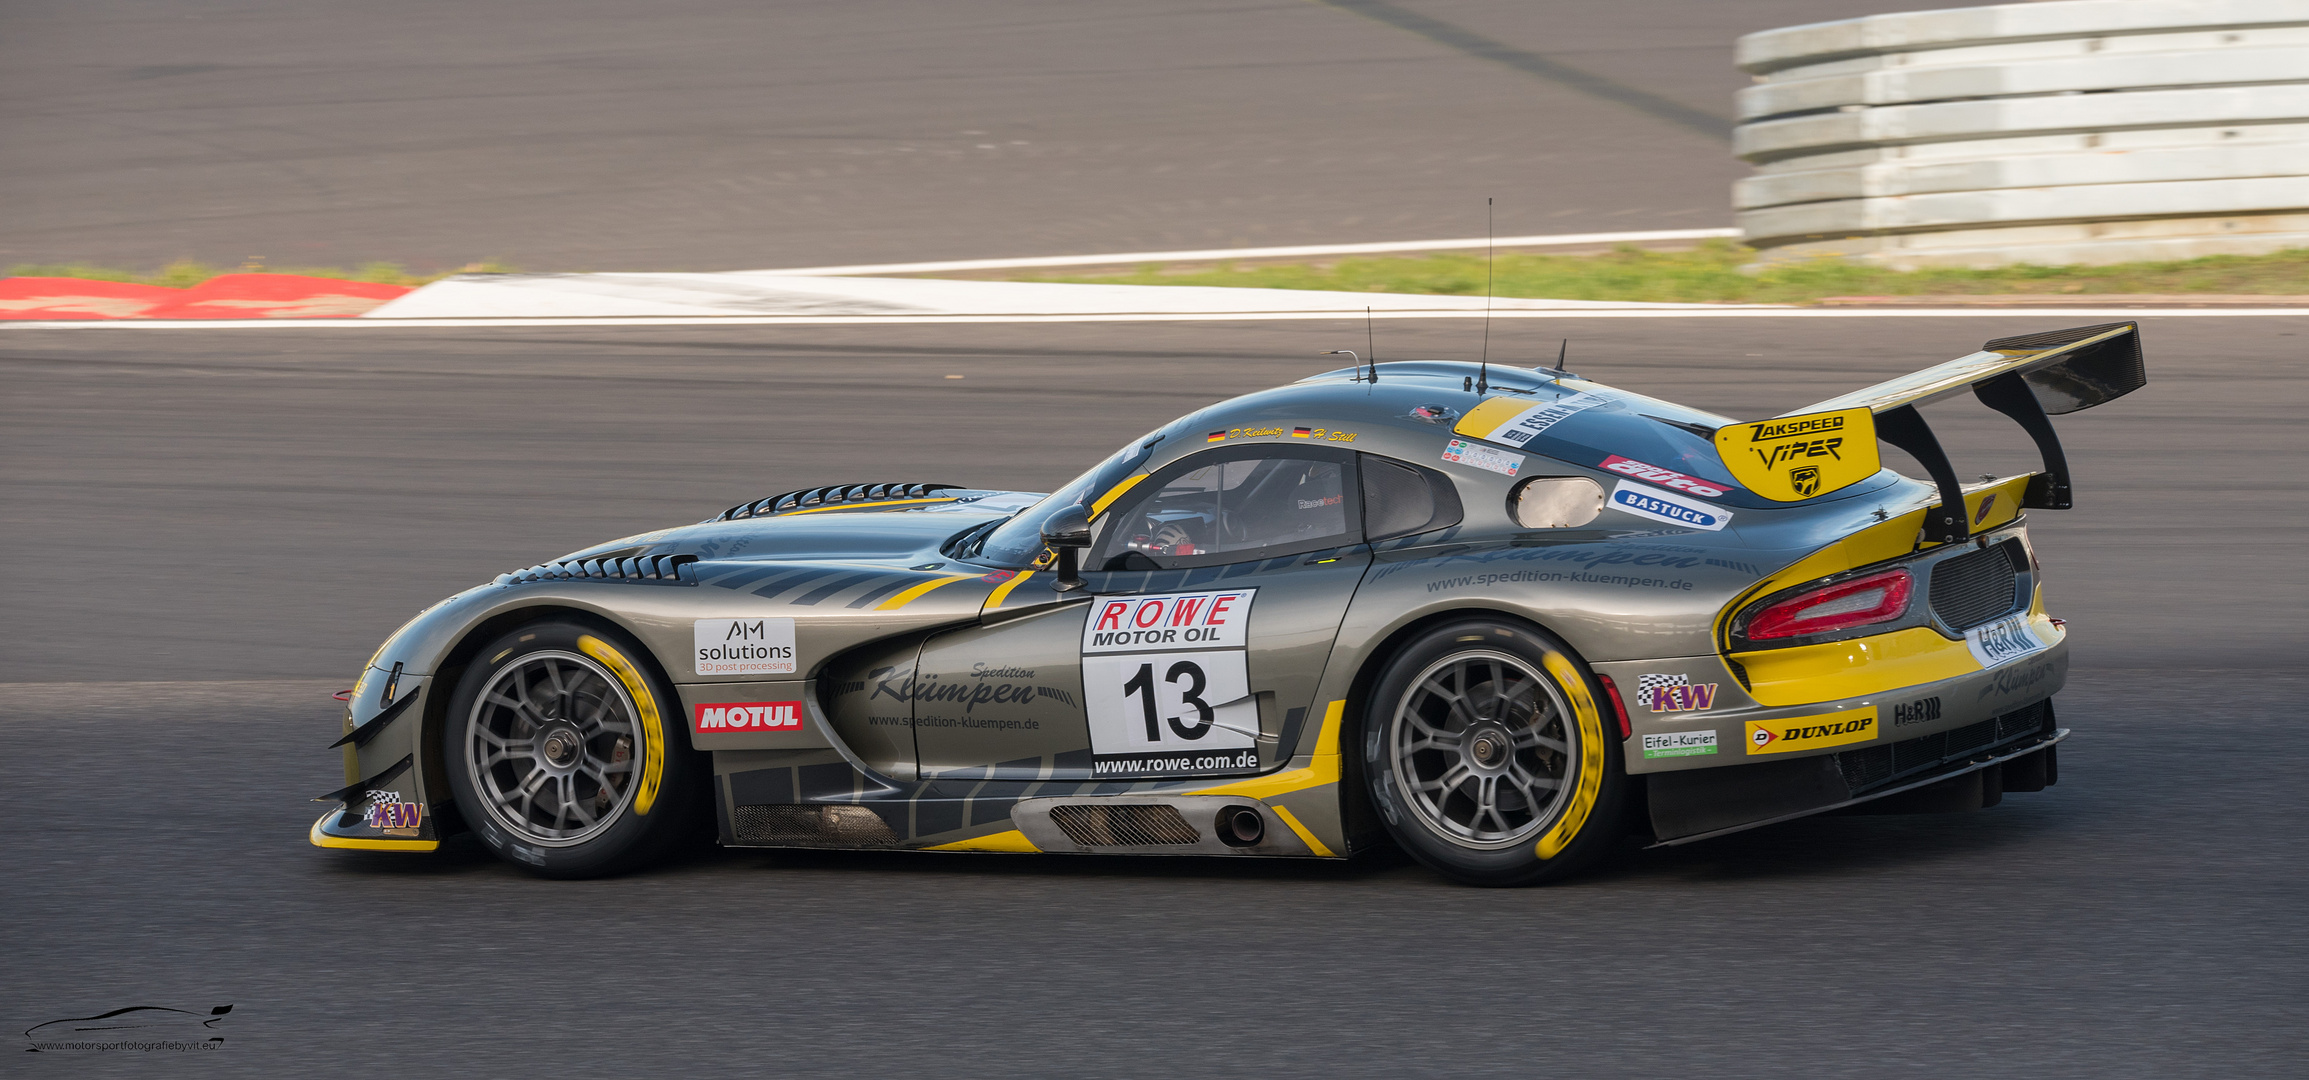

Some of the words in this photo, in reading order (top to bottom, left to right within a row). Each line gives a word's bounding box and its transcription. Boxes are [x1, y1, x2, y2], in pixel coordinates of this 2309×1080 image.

[1749, 416, 1844, 442] ZAKSPEED
[1757, 437, 1843, 471] VIPER
[1607, 463, 1723, 497] auto
[1625, 494, 1706, 524] BASTUCK
[1427, 570, 1693, 593] www.spedition-kluempen.de
[1095, 596, 1238, 631] ROWE
[726, 620, 764, 640] AM
[1092, 629, 1177, 647] MOTOR
[1184, 627, 1221, 642] OIL
[699, 644, 792, 660] solutions
[700, 663, 713, 672] 3D
[715, 662, 737, 673] post
[740, 661, 793, 672] processing
[970, 662, 1036, 681] Spedition
[868, 666, 1036, 713] Klümpen
[1651, 683, 1718, 713] KW
[1124, 661, 1215, 742] 13
[700, 706, 799, 728] MOTUL
[868, 715, 1040, 731] www.spedition-kluempen.de
[1644, 733, 1715, 749] Eifel-Kurier
[1782, 718, 1873, 741] DUNLOP
[1095, 751, 1258, 774] www.rowe.com.de
[370, 802, 424, 828] KW
